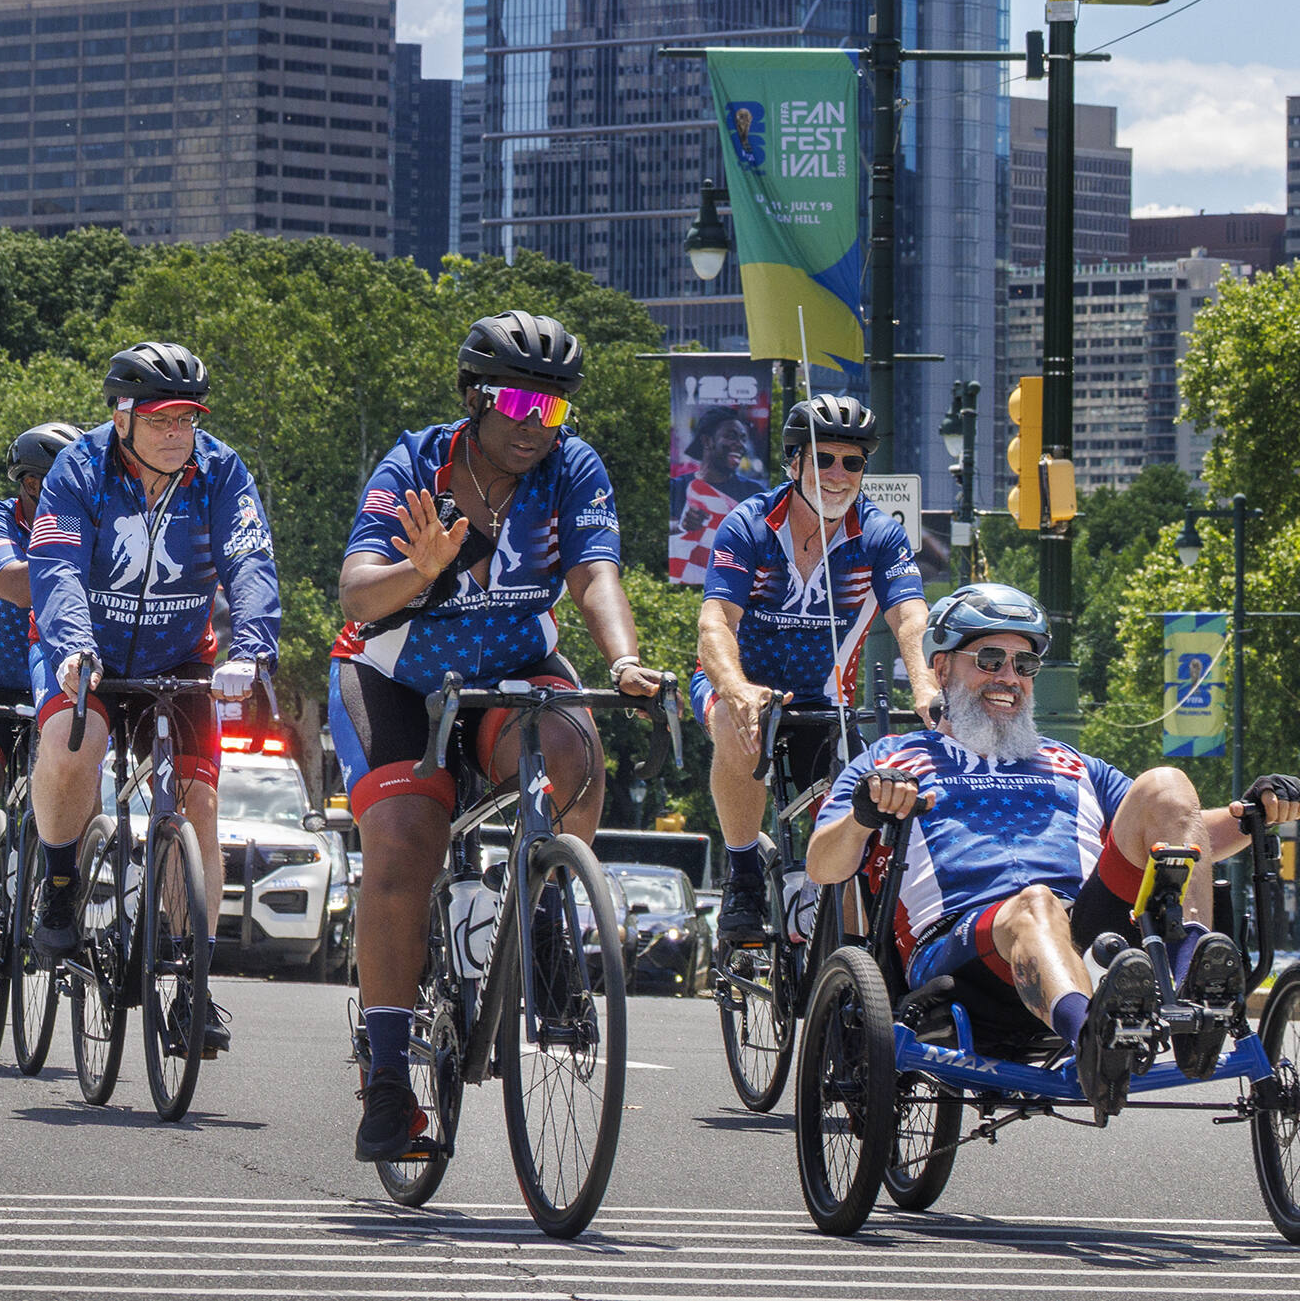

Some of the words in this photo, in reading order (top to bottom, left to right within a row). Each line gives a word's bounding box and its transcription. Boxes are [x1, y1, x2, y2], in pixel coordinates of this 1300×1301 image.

[780, 102, 789, 124] FIFA
[792, 102, 845, 124] FAN
[781, 127, 847, 150] FEST
[837, 154, 846, 177] 2026
[791, 202, 817, 212] JULY
[819, 202, 833, 211] 19
[794, 214, 821, 224] HILL
[491, 588, 550, 600] WARRIOR
[754, 610, 800, 625] WOUNDED
[996, 777, 1057, 785] WARRIOR
[923, 1045, 1000, 1075] MAX
